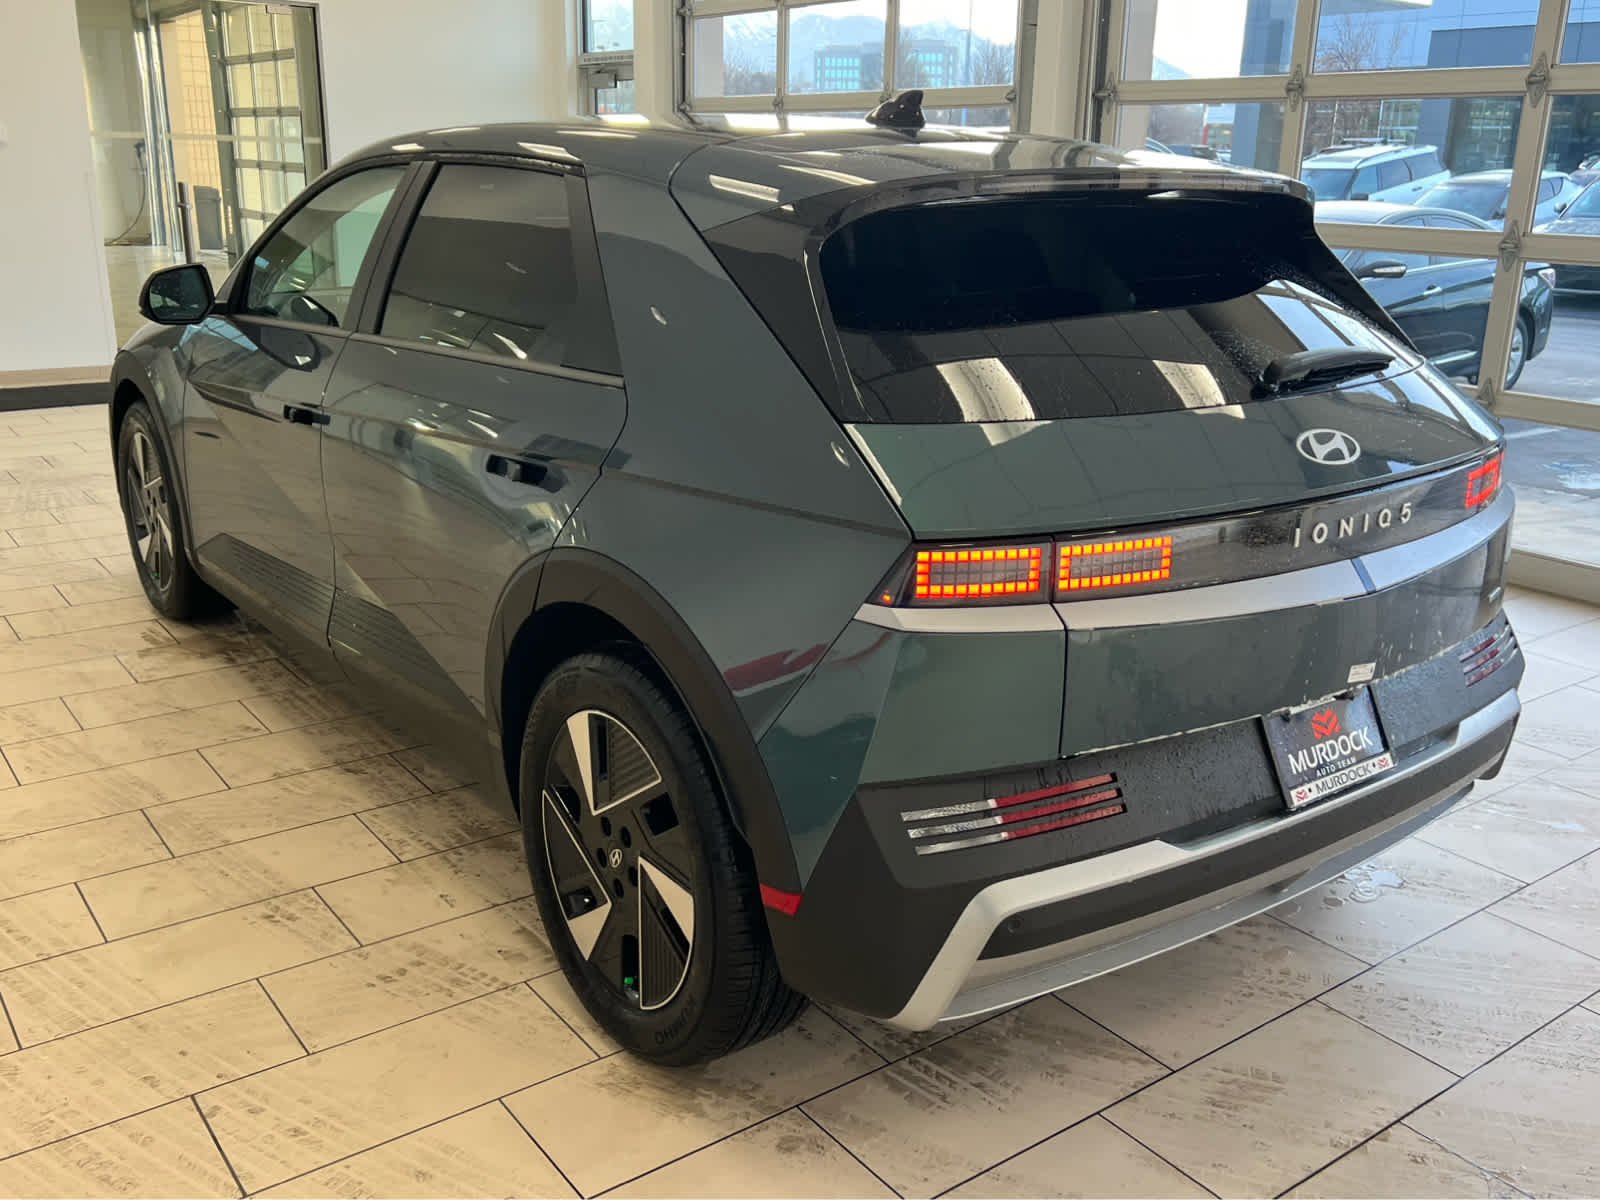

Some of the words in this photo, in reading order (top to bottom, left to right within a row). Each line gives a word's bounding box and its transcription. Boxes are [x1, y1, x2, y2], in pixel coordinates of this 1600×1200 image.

[1288, 727, 1374, 775] MURDOCK
[1316, 763, 1336, 777] AUTO
[1337, 756, 1357, 769] TEAM
[1315, 763, 1372, 795] MURDOCK
